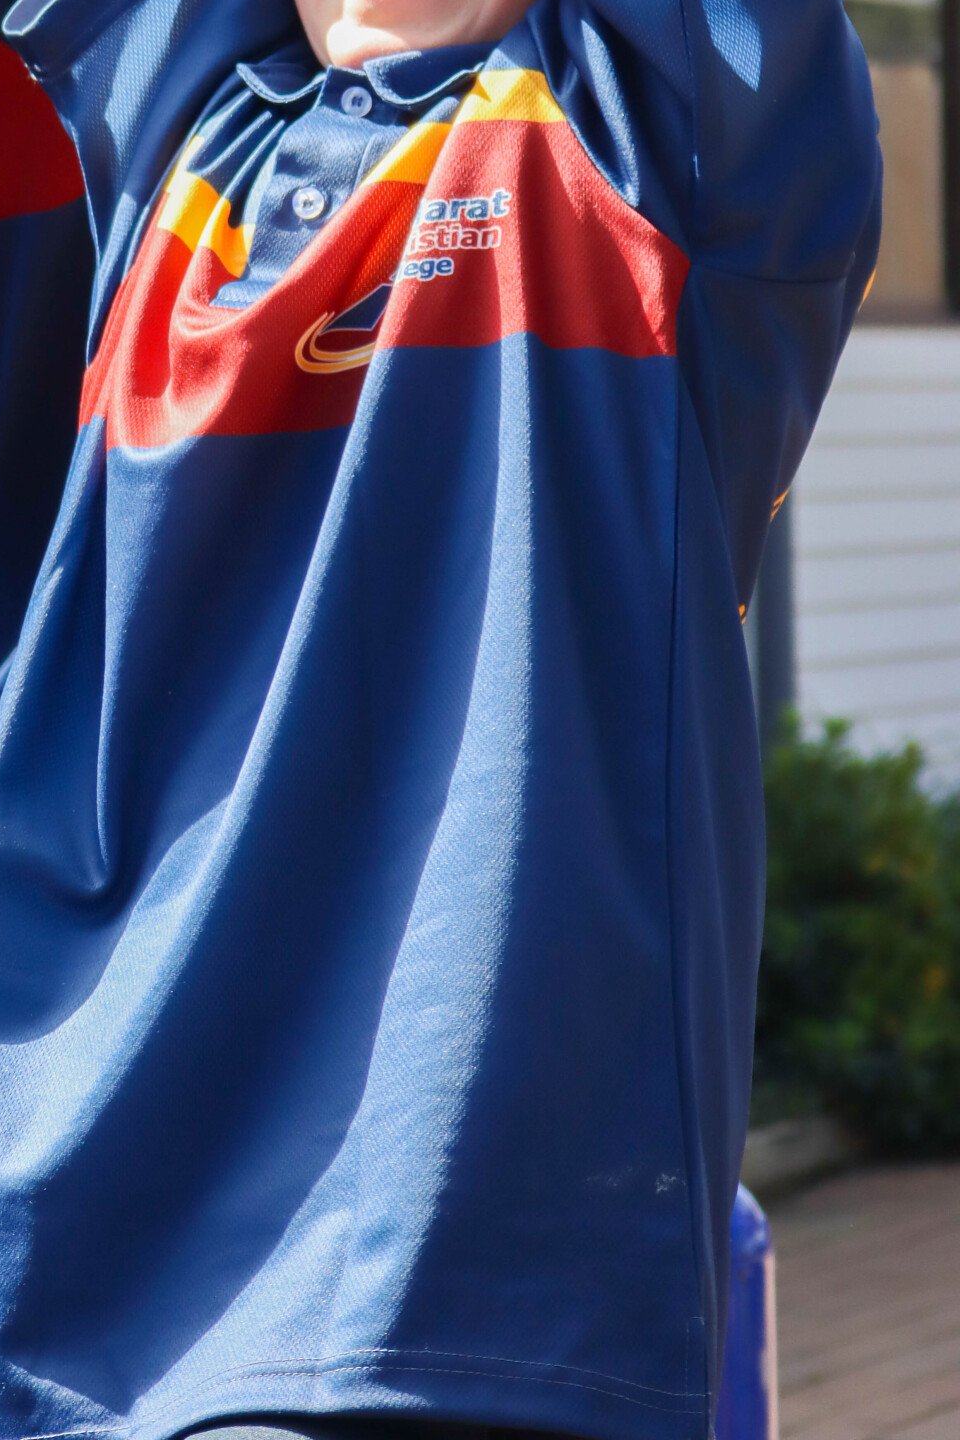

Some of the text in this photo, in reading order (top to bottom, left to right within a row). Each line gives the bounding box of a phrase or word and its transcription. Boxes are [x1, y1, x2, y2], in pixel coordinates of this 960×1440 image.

[421, 188, 510, 222] arat
[406, 223, 501, 255] istian
[400, 257, 454, 281] ege
